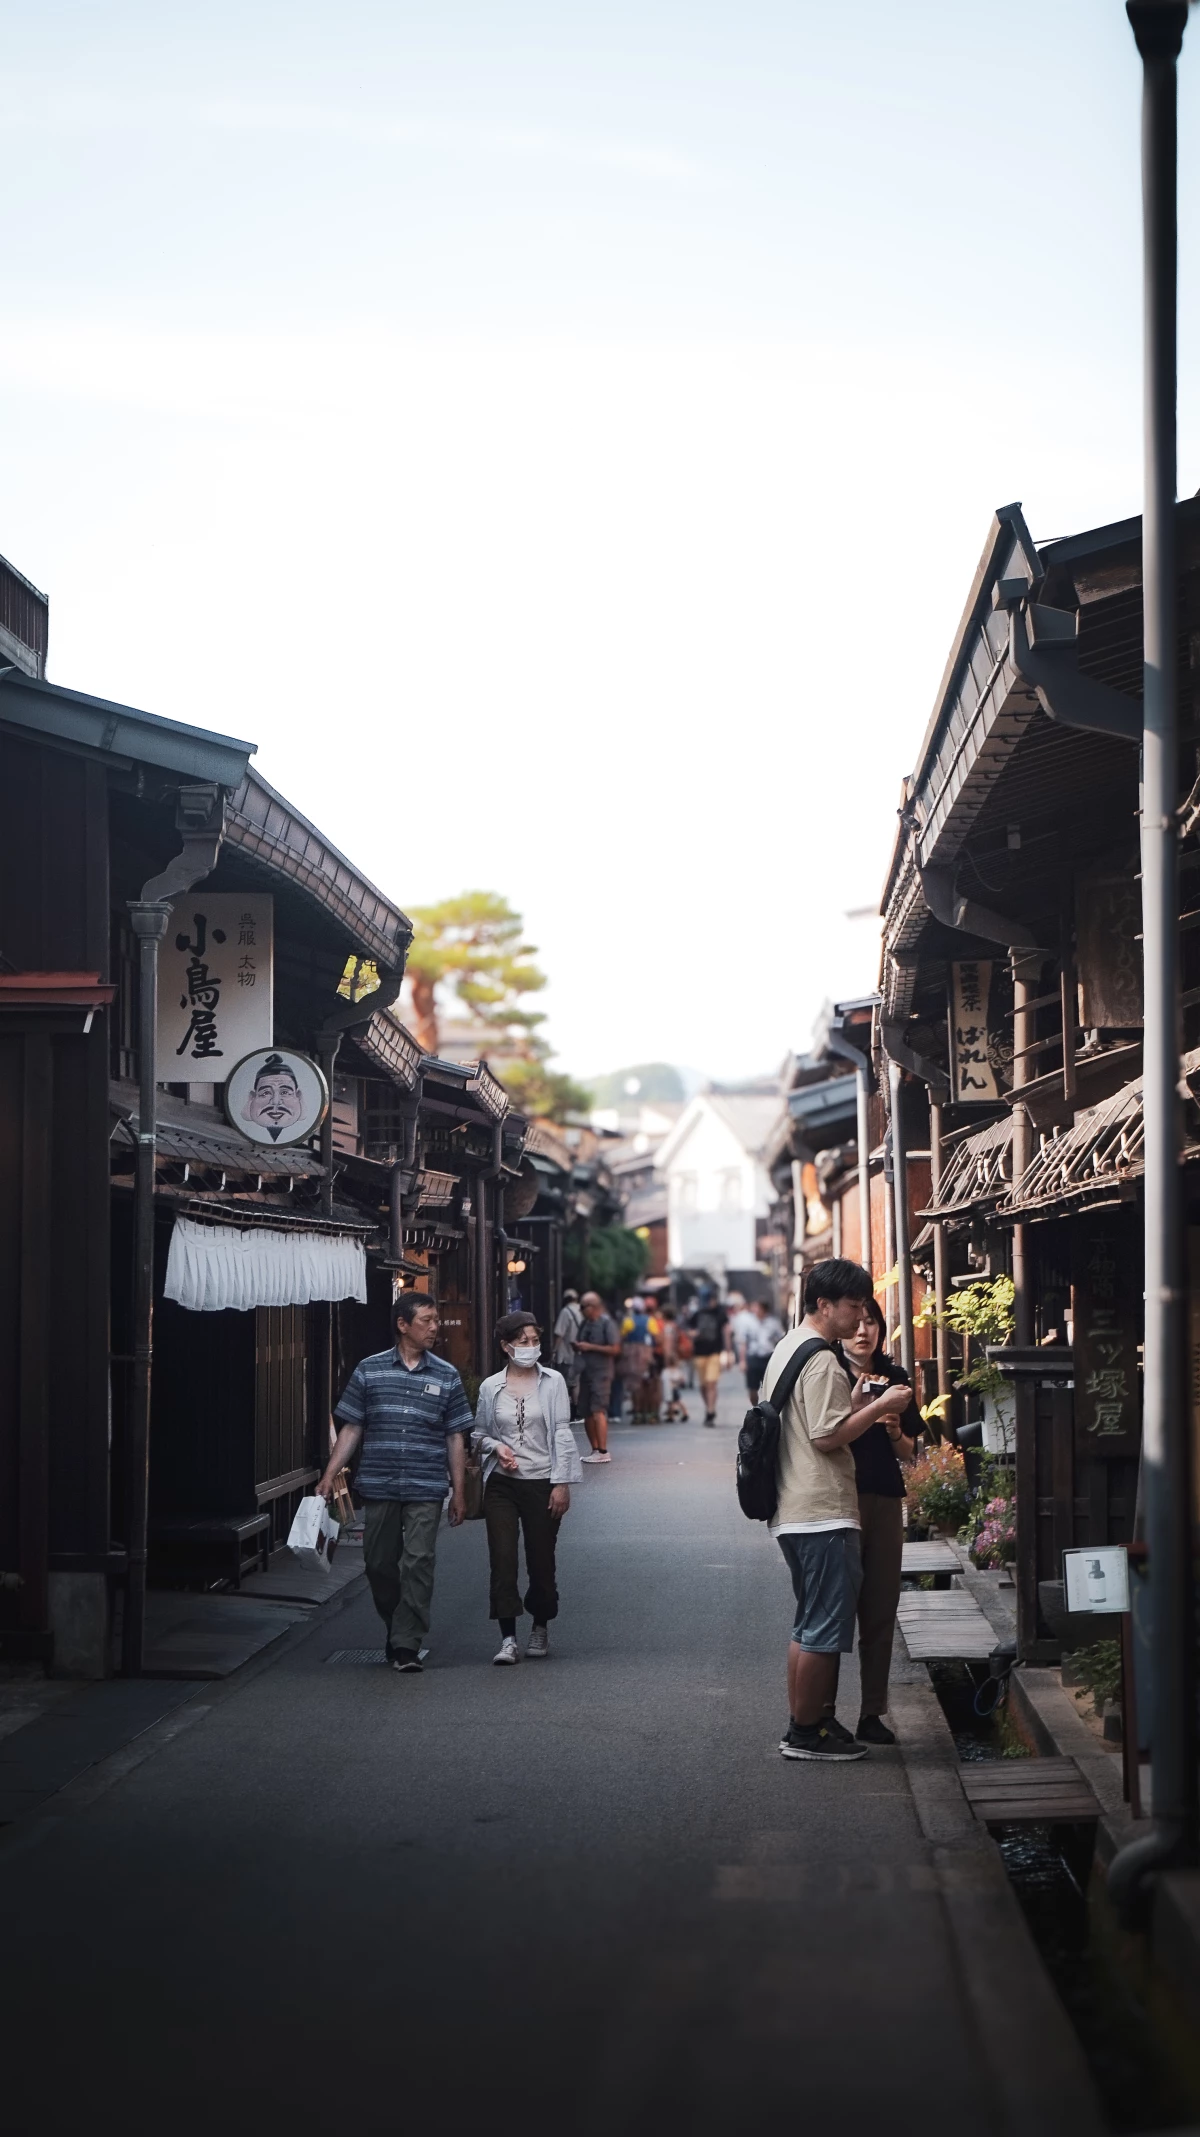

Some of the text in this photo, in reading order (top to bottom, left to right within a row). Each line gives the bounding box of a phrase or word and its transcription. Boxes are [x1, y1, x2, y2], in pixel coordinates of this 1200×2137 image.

[175, 913, 227, 1059] 小鳥屋
[237, 912, 257, 987] 呉服 太物
[956, 1026, 988, 1091] ばれん
[1085, 1308, 1130, 1437] 三ツ塚屋
